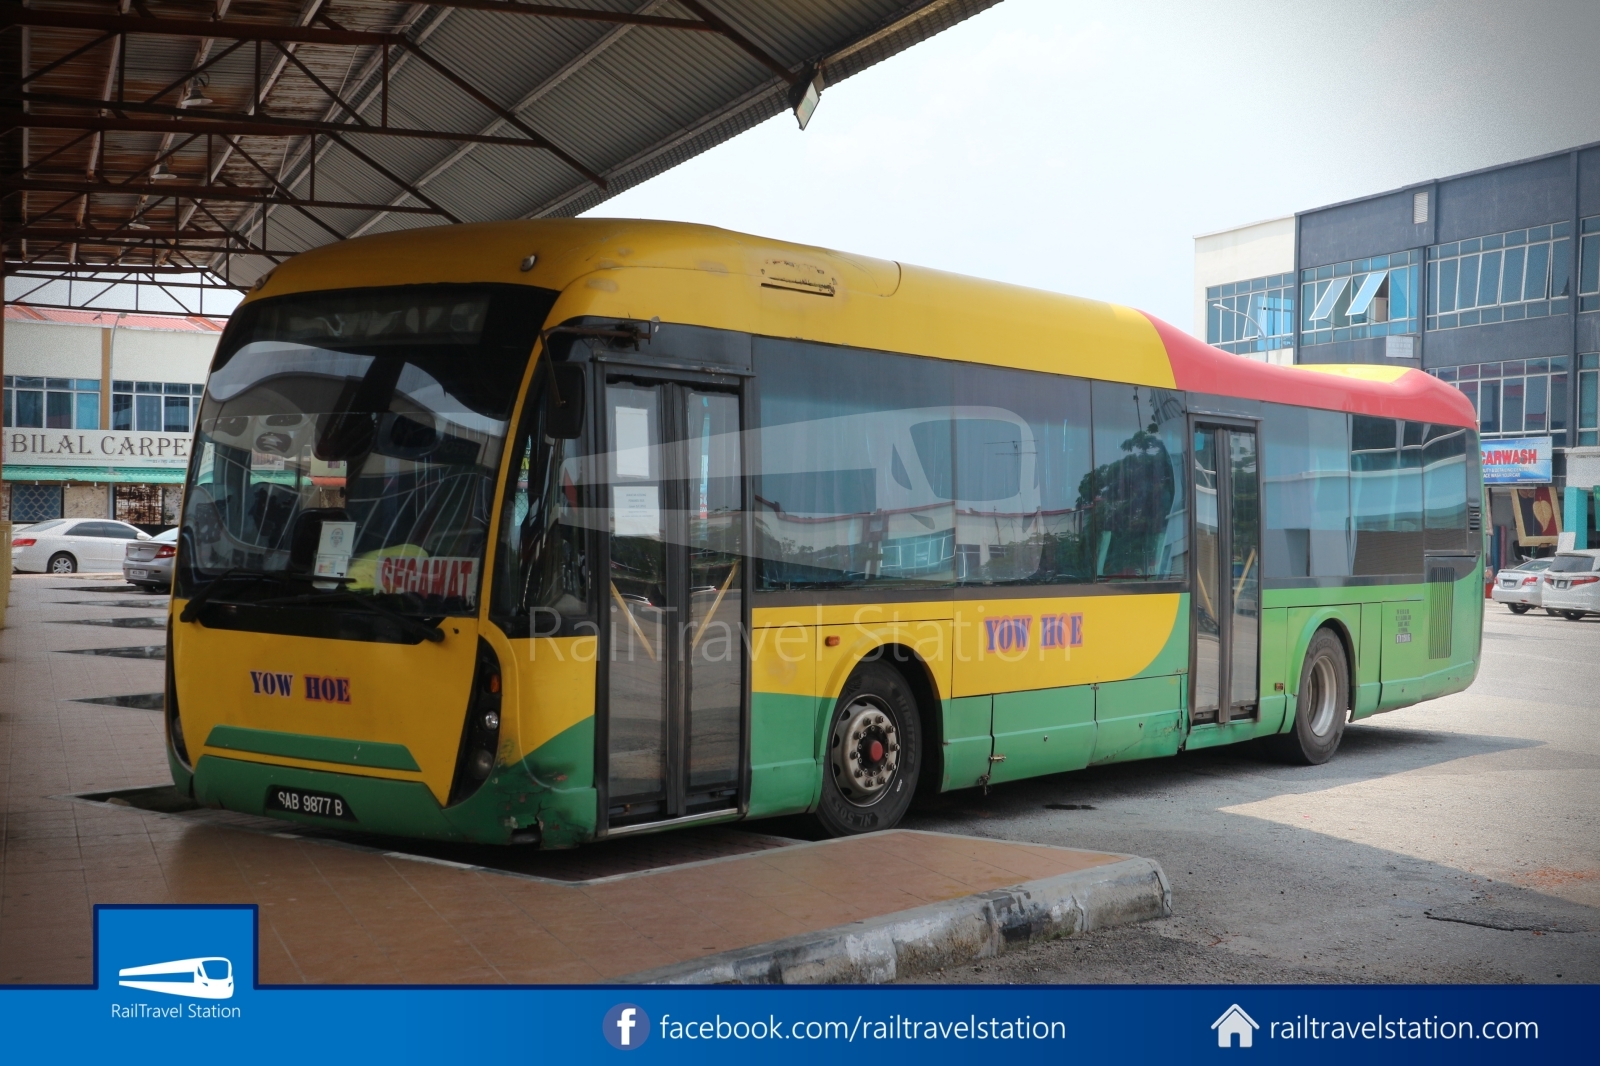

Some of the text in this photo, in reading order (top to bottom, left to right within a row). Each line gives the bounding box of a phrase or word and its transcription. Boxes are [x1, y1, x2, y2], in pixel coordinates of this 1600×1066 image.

[11, 433, 92, 455] BILAL
[100, 435, 192, 457] CARPE
[1481, 448, 1537, 465] CARWASH
[381, 557, 473, 599] SEGAMAT
[983, 615, 1033, 654] YOW
[249, 669, 352, 705] YOW HOE
[278, 791, 343, 816] SAB 9877 B
